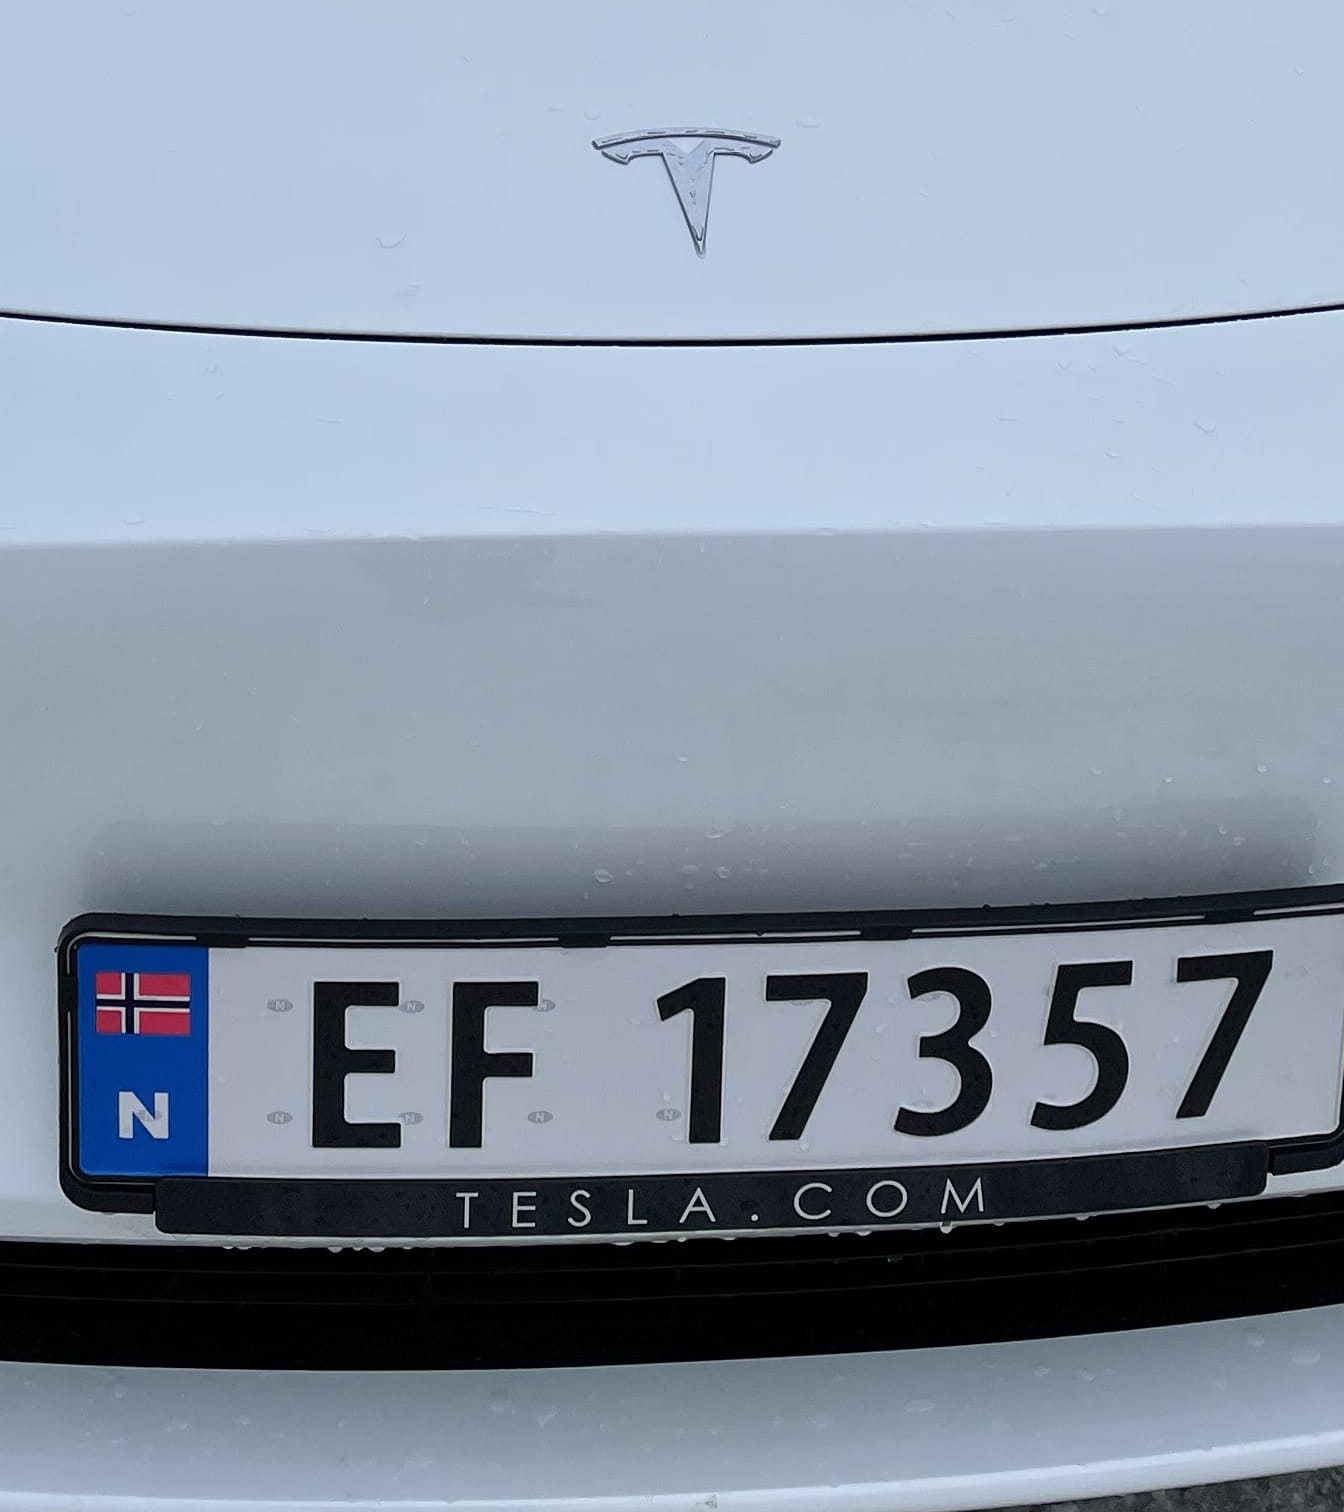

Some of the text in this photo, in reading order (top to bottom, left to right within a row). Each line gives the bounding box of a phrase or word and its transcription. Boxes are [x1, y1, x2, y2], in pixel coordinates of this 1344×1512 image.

[311, 949, 1274, 1149] EF 17357
[118, 1091, 169, 1140] N
[455, 1177, 986, 1229] TESLA.COM
